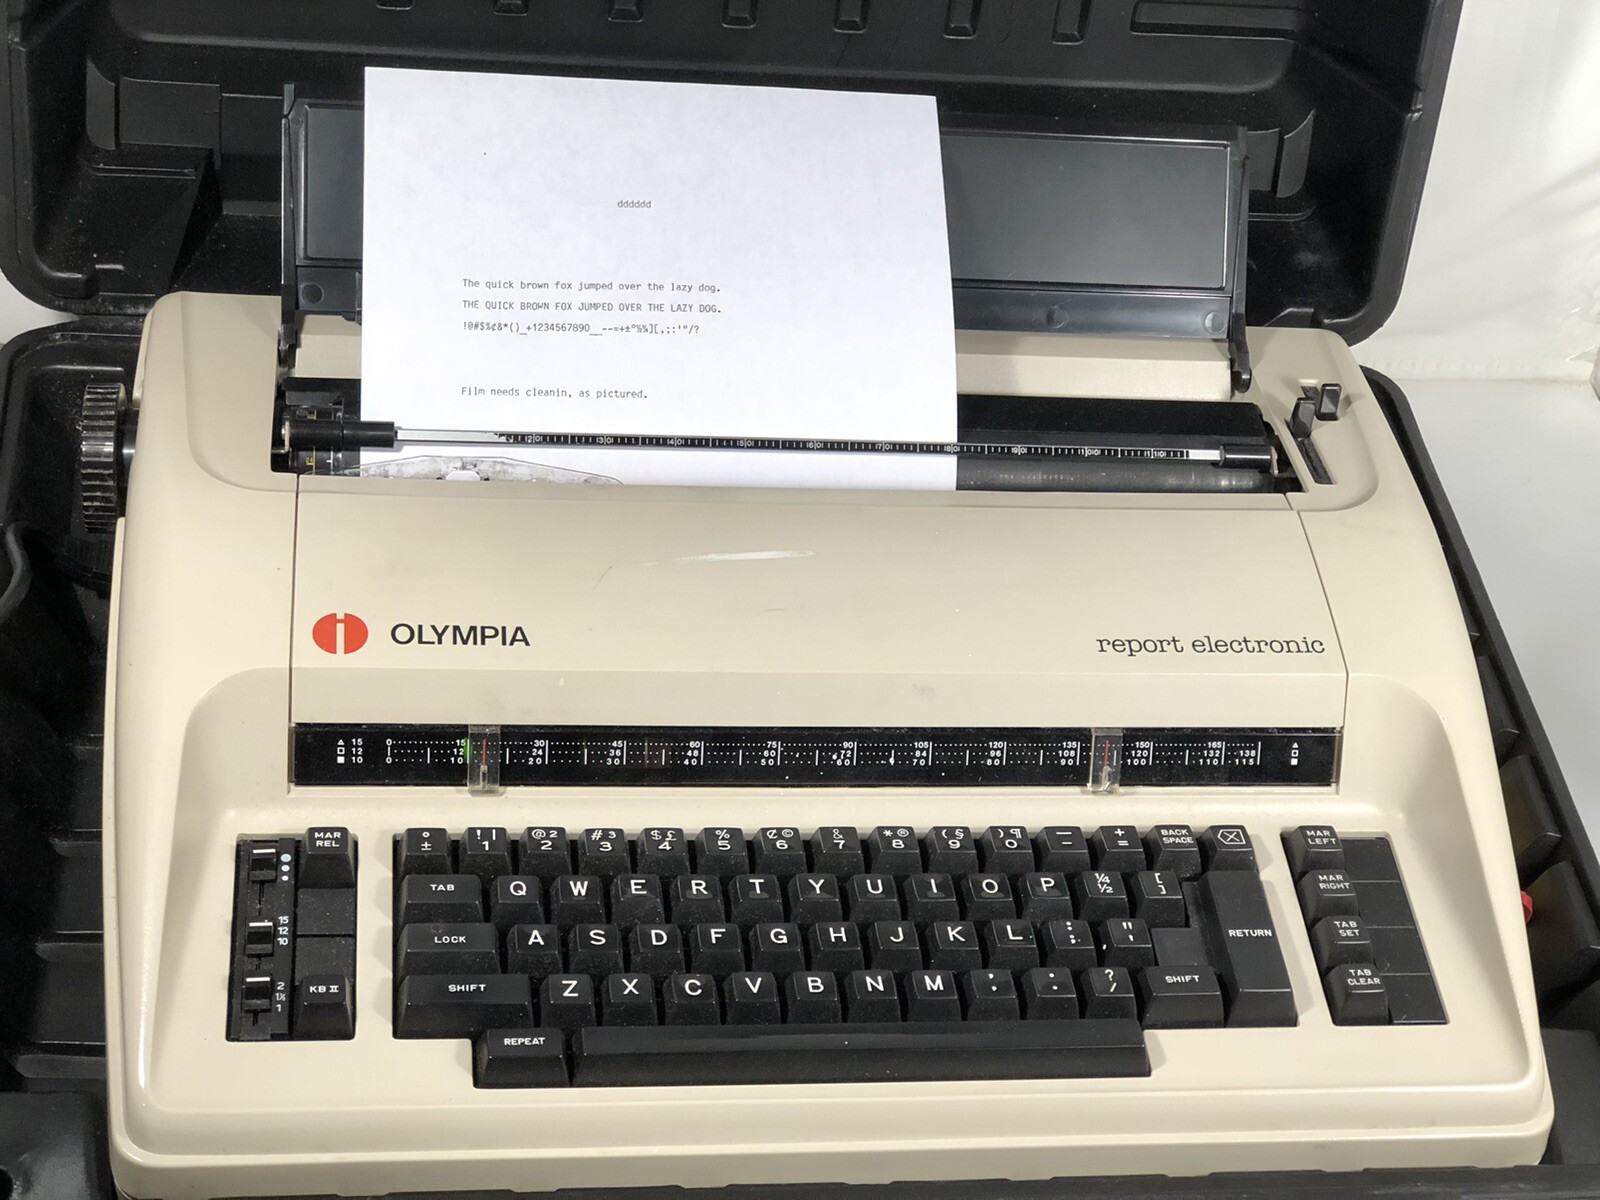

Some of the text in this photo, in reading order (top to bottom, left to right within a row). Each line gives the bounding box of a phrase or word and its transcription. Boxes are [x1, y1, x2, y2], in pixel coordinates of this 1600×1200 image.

[617, 200, 651, 208] dddddd
[463, 279, 479, 287] The
[486, 280, 514, 289] quick
[521, 281, 549, 289] brown
[556, 281, 572, 289] fox
[578, 282, 612, 291] jumped
[672, 283, 693, 293] lazy
[699, 284, 720, 293] dog.
[463, 300, 721, 313] THE QUICK BROWN FOX JUMPED OVER THE LAZY DOG.
[462, 387, 485, 395] Film
[491, 388, 519, 396] needs
[526, 388, 571, 398] cleanin,
[597, 389, 647, 398] pictured.
[391, 623, 530, 646] OLYMPIA
[1096, 636, 1324, 656] report electronic
[715, 829, 730, 839] %
[833, 829, 843, 839] &
[1161, 827, 1191, 835] BACK
[482, 841, 489, 850] 1
[541, 840, 552, 850] 2
[600, 842, 612, 851] 3
[658, 840, 671, 850] 4
[718, 841, 730, 850] 5
[776, 840, 788, 849] 6
[834, 840, 845, 849] 7
[892, 839, 904, 848] 8
[949, 838, 962, 848] 9
[510, 881, 526, 895] Q
[570, 881, 588, 896] W
[631, 880, 647, 894] E
[691, 880, 707, 894] R
[749, 879, 764, 894] T
[809, 879, 824, 894] Y
[867, 879, 883, 894] U
[931, 879, 937, 893] I
[982, 879, 998, 893] O
[1041, 878, 1054, 891] P
[278, 916, 288, 924] 15
[528, 930, 544, 945] A
[590, 930, 606, 945] S
[651, 930, 667, 945] D
[711, 929, 726, 943] F
[770, 928, 787, 943] G
[829, 927, 846, 942] H
[890, 927, 903, 942] J
[947, 926, 965, 941] K
[1007, 925, 1023, 940] L
[277, 982, 284, 990] 2
[745, 978, 761, 993] V
[807, 977, 824, 992] B
[866, 976, 884, 991] N
[924, 975, 943, 990] M
[1165, 975, 1199, 983] SHIFT
[449, 984, 486, 992] SHIFT
[562, 980, 578, 996] Z
[622, 979, 638, 994] X
[685, 979, 702, 995] C
[277, 1004, 281, 1012] 1
